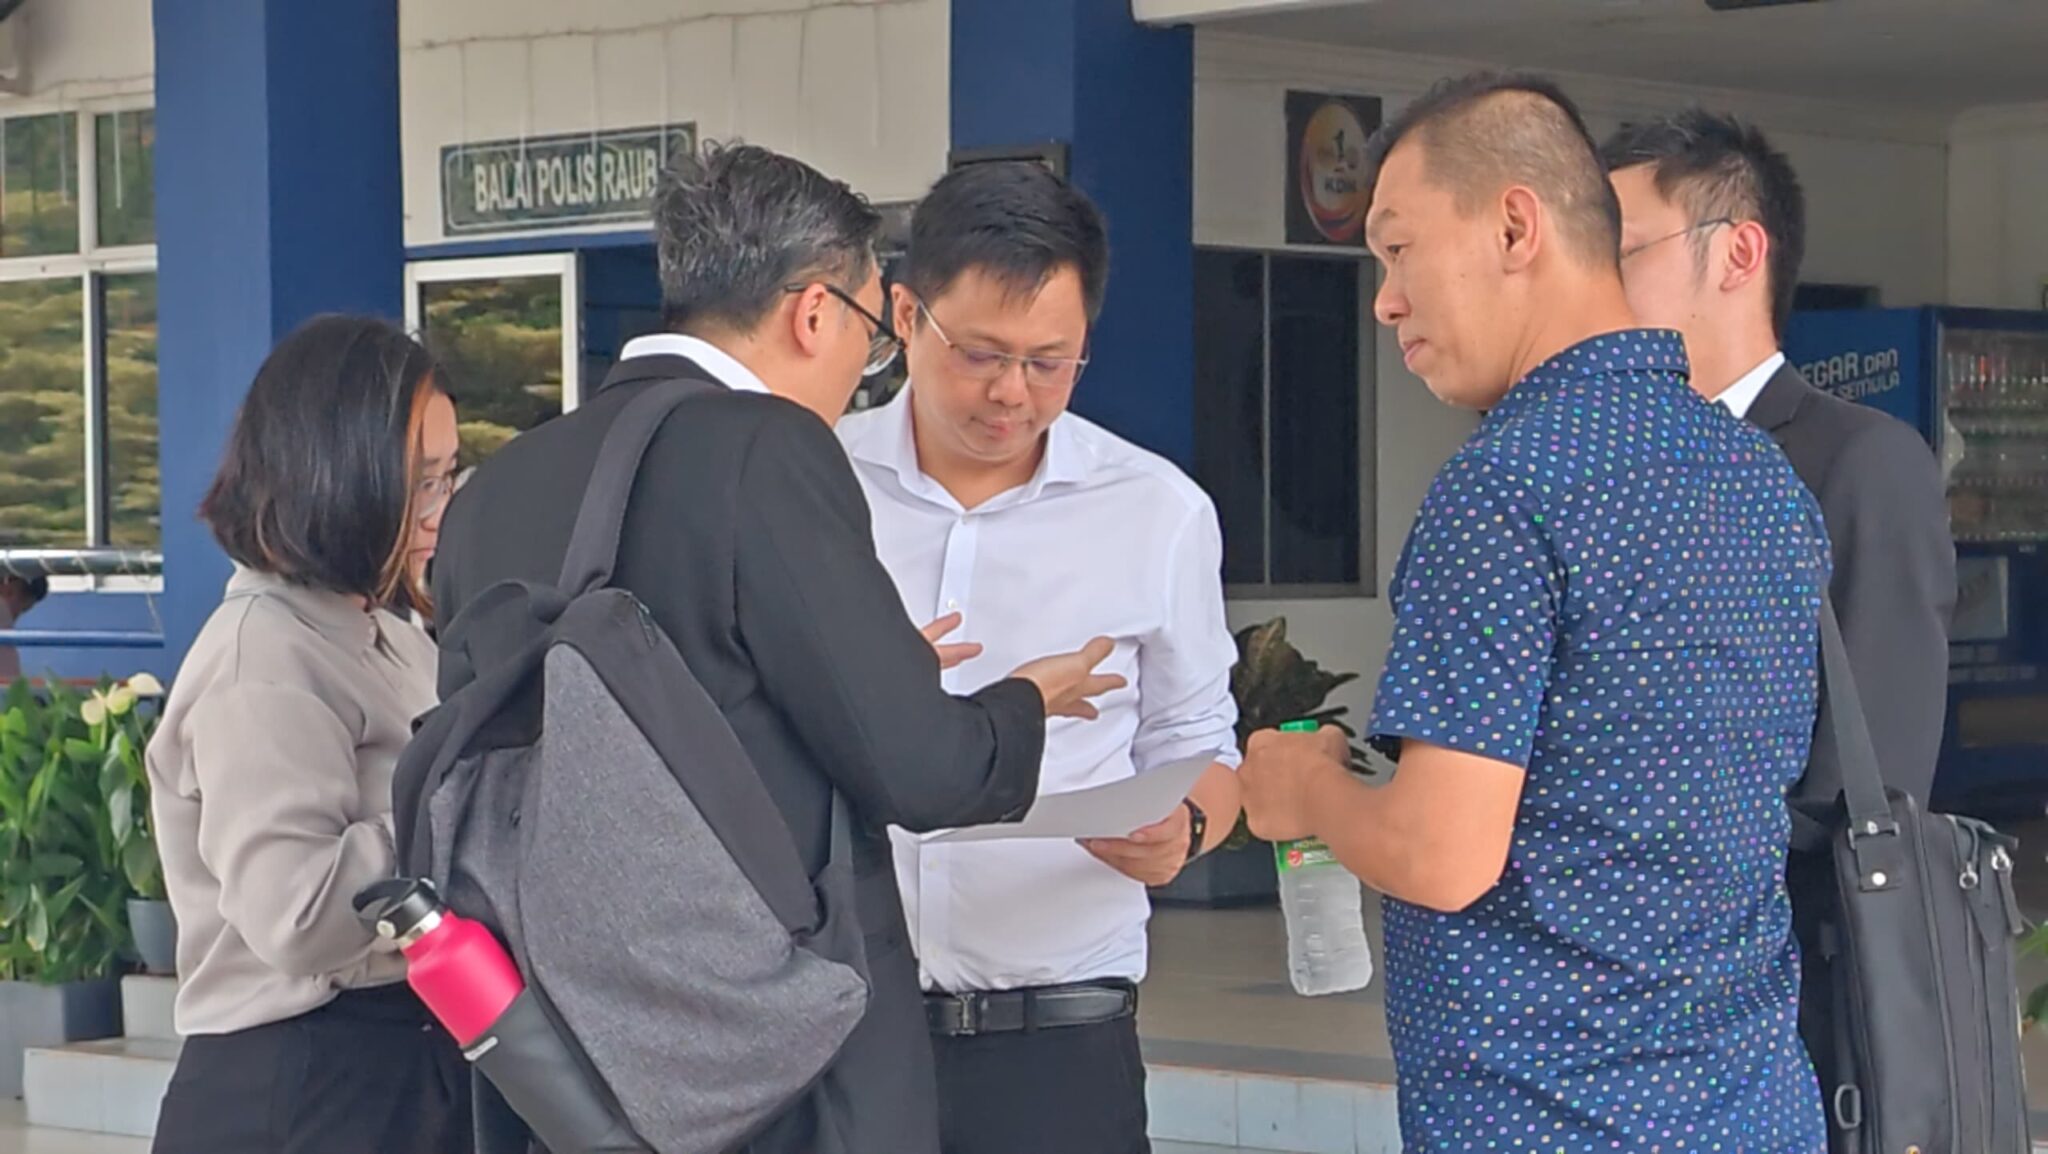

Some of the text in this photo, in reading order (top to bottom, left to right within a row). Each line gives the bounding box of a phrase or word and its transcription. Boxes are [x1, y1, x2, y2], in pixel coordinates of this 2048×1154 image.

[474, 149, 659, 212] BALAI POLIS RAUB
